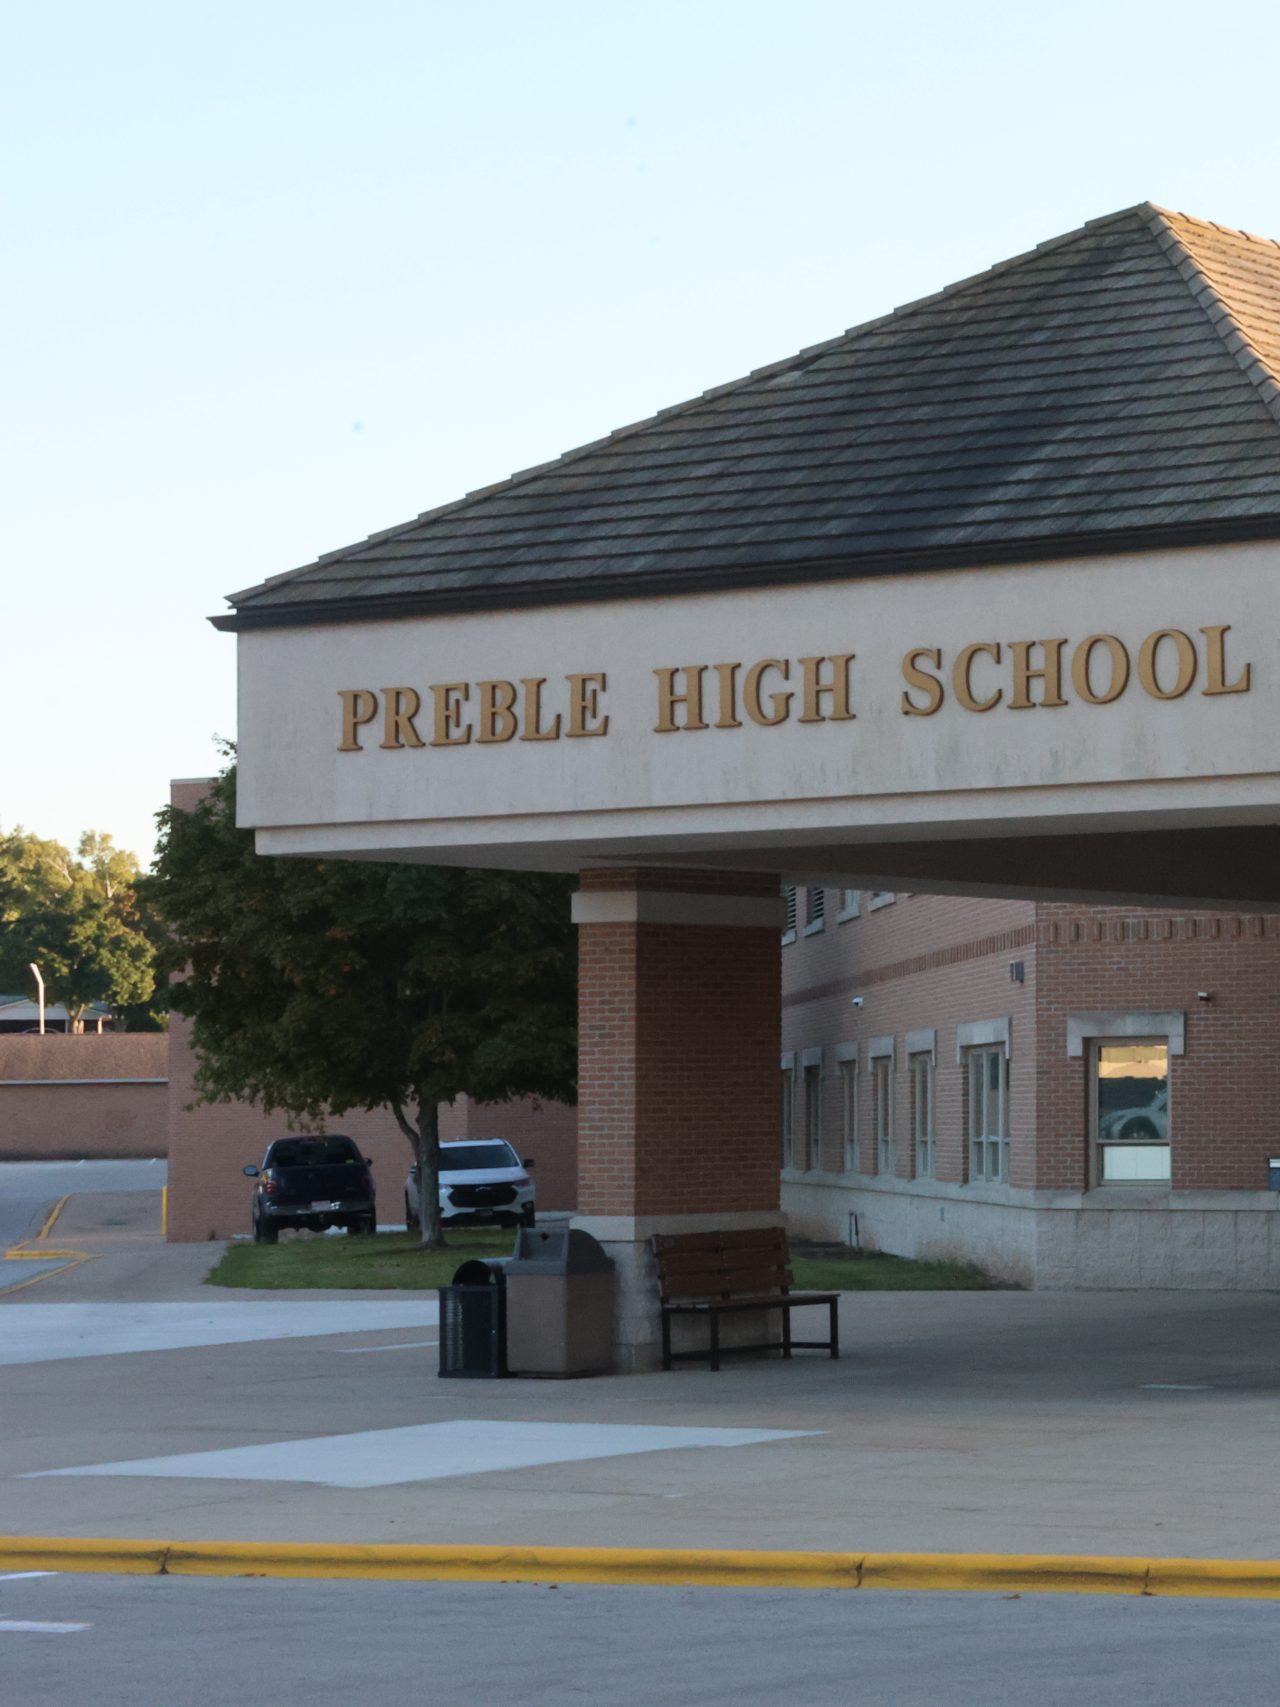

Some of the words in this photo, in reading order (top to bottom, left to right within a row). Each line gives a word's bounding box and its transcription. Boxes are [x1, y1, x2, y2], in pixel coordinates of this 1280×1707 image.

[337, 672, 609, 752] PREBLE
[653, 654, 856, 733] HIGH
[901, 625, 1252, 717] SCHOOL
